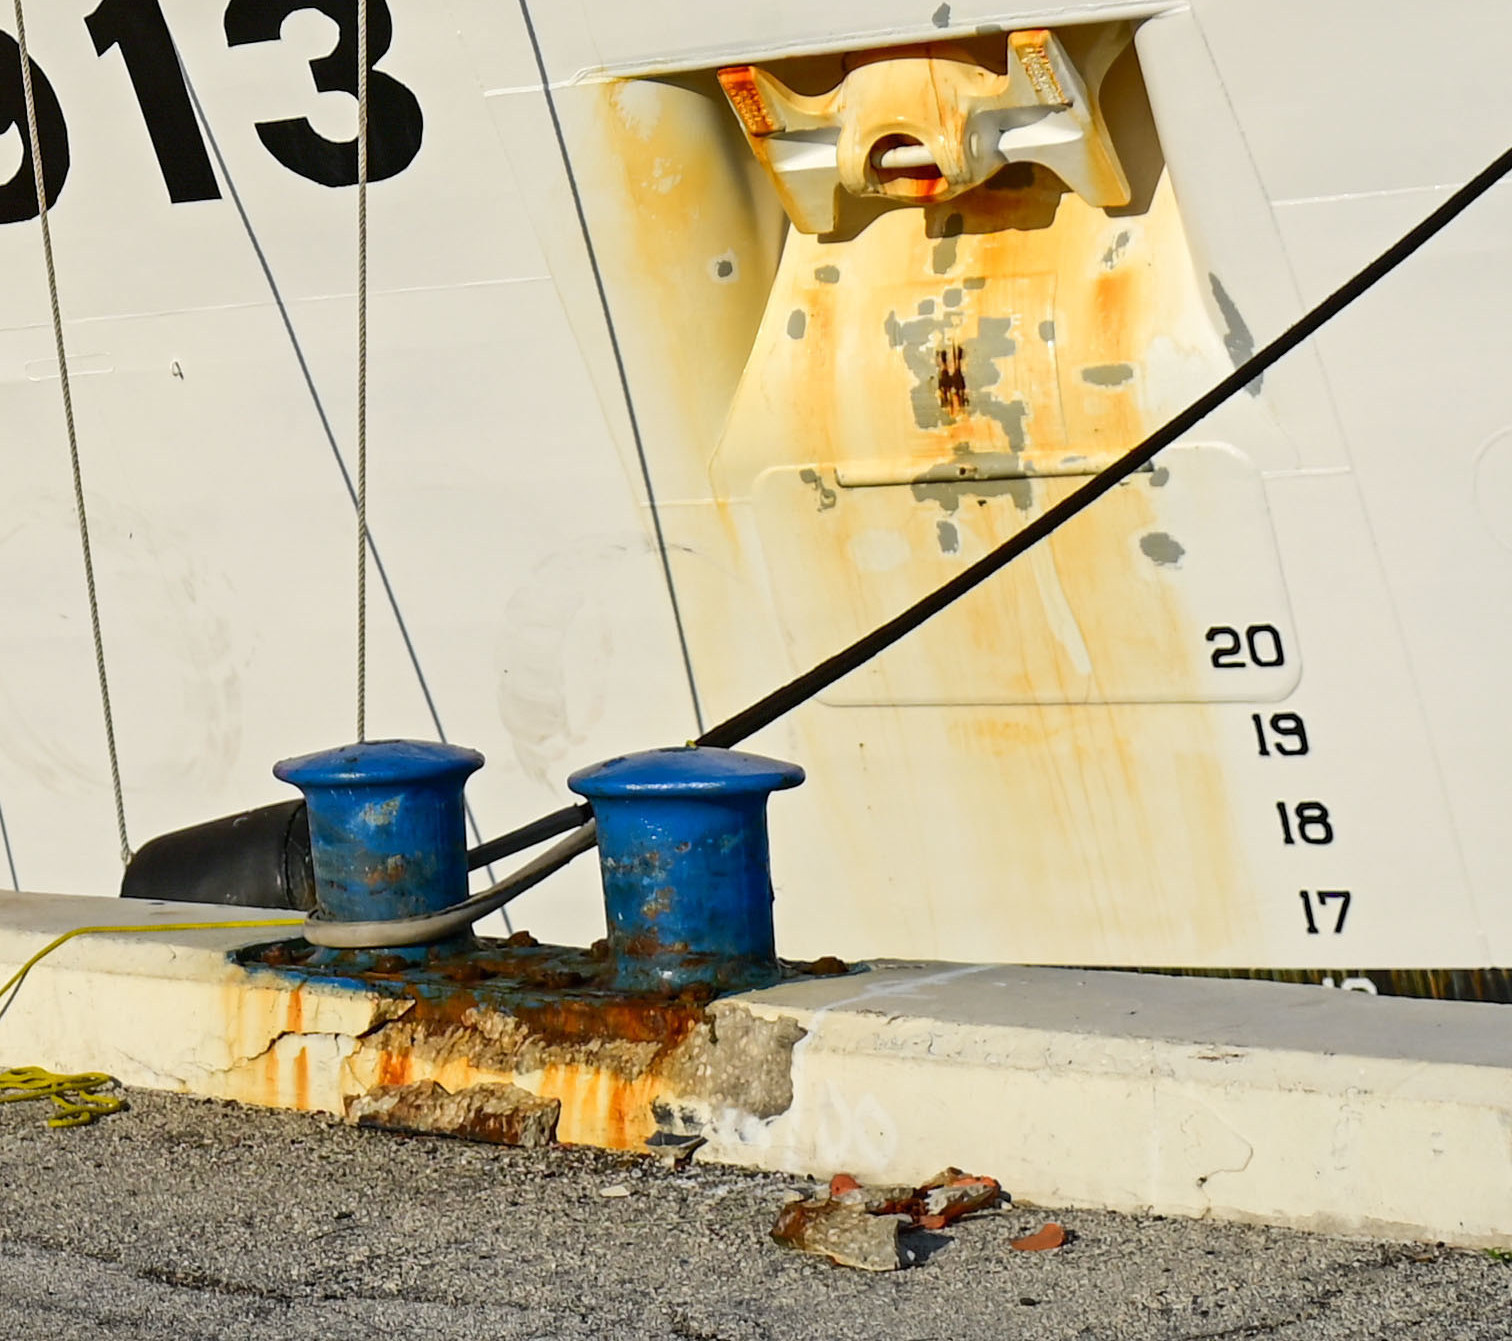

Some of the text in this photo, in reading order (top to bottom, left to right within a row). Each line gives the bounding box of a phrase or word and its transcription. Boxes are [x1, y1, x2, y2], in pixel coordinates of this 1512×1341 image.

[1205, 623, 1286, 668] 20
[1251, 712, 1310, 757] 19
[1276, 801, 1334, 846] 18
[1299, 890, 1351, 934] 17
